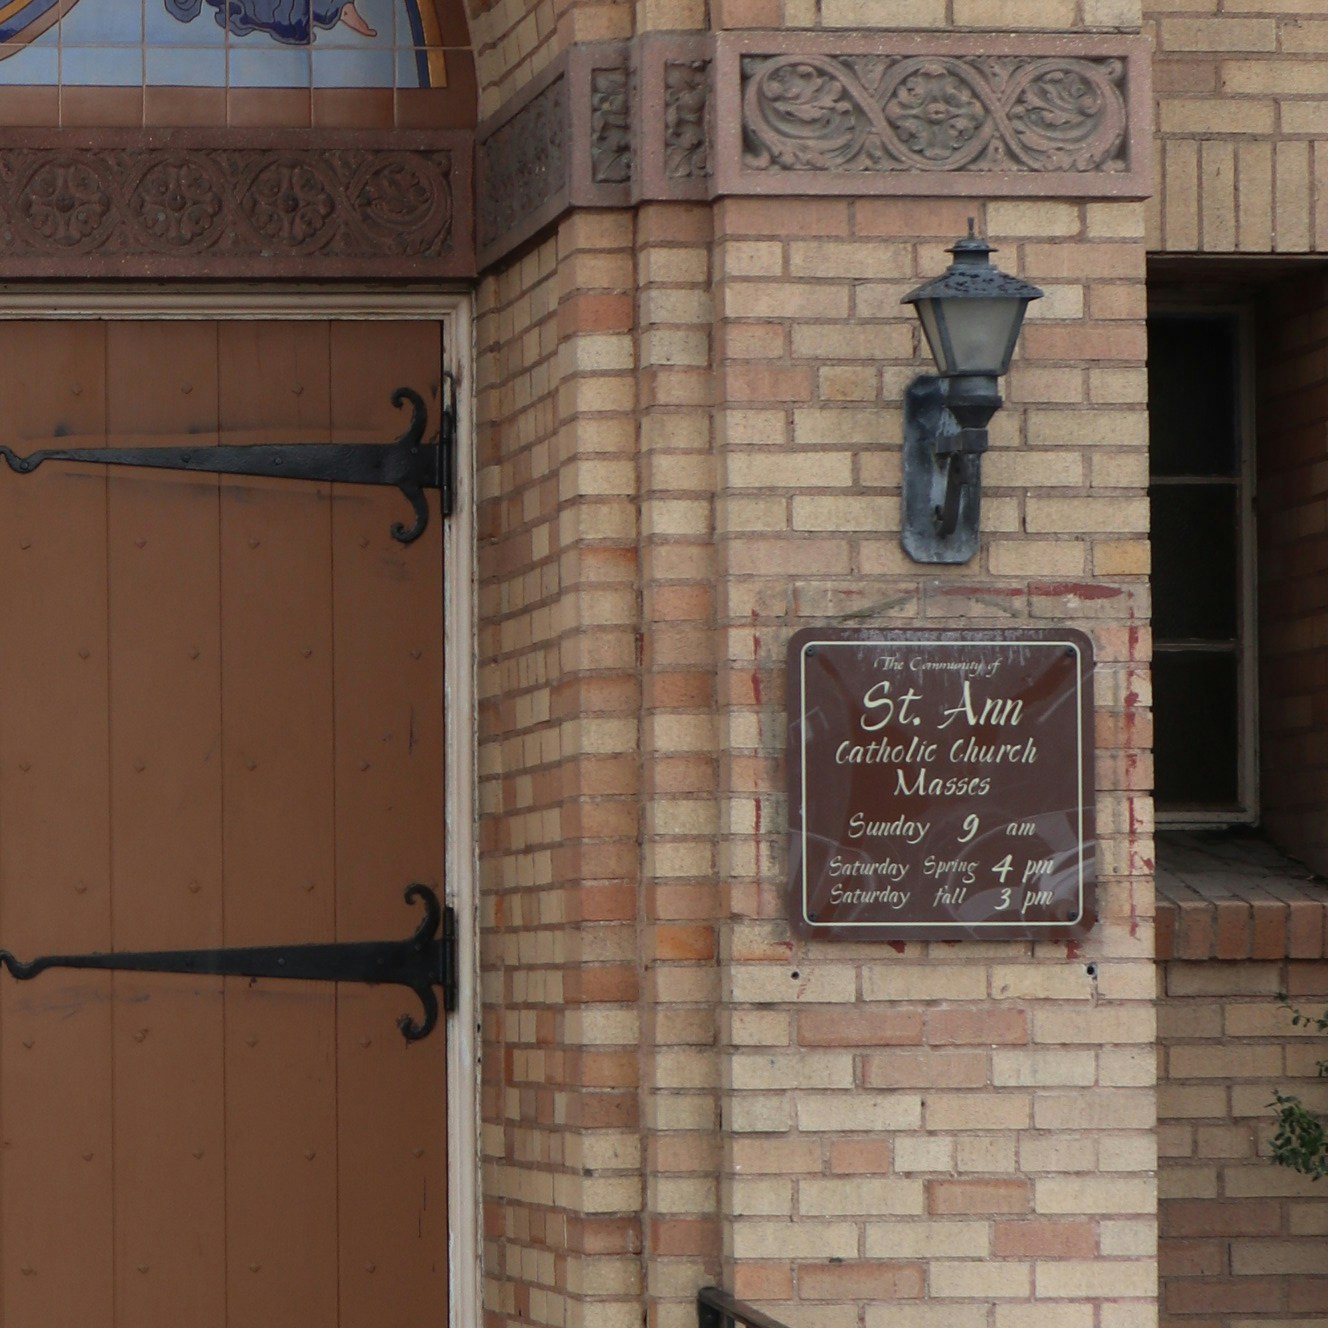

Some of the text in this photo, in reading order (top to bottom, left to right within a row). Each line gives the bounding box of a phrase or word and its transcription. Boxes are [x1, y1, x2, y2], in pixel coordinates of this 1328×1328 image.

[873, 654, 1003, 678] The Community of
[860, 680, 1024, 731] St. Ann
[835, 736, 1038, 764] Catholic Church
[893, 767, 991, 796] Masses
[848, 812, 1037, 844] Sunday 9 am
[828, 853, 1055, 884] Saturday Spring 4 pm
[829, 883, 911, 910] Saturday
[993, 887, 1012, 911] 3
[1021, 889, 1055, 915] pm
